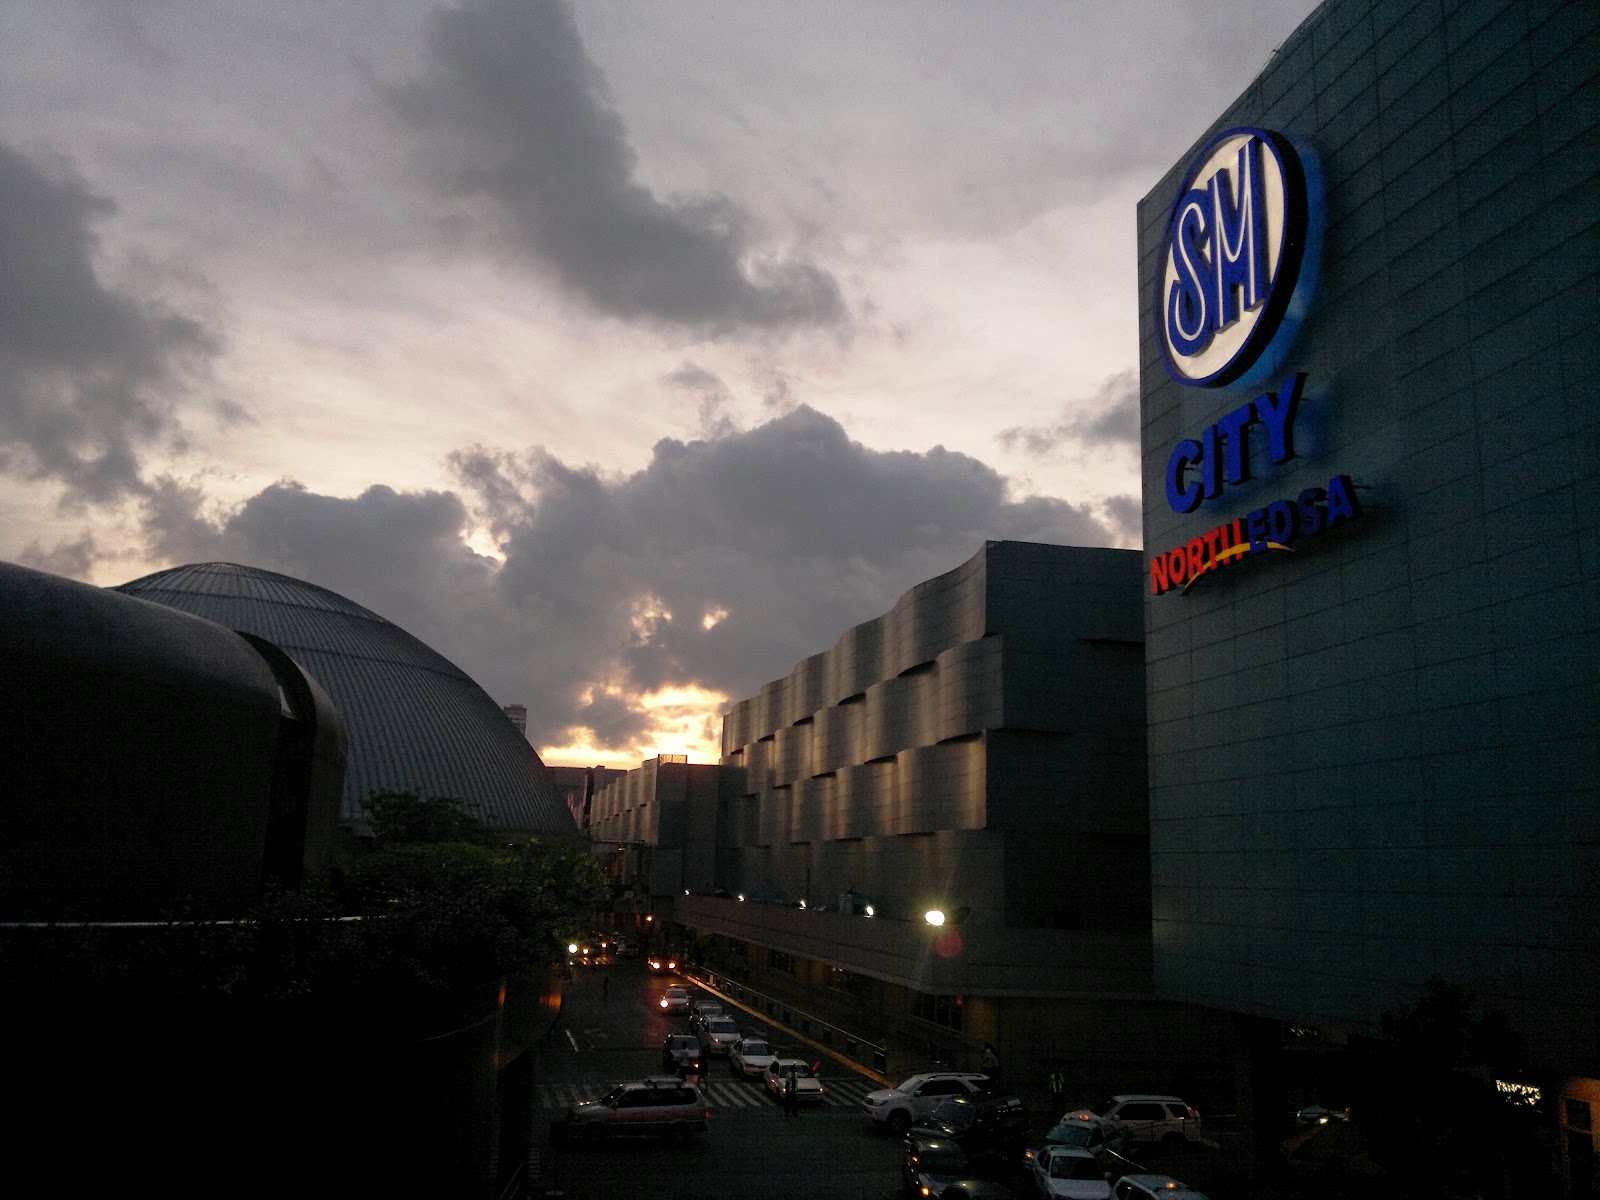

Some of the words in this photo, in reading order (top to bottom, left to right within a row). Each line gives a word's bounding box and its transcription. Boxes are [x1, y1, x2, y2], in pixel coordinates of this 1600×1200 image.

[1168, 138, 1264, 357] SM
[1166, 372, 1306, 513] CITY
[1151, 519, 1249, 595] NORTH
[1246, 475, 1361, 556] EDSA
